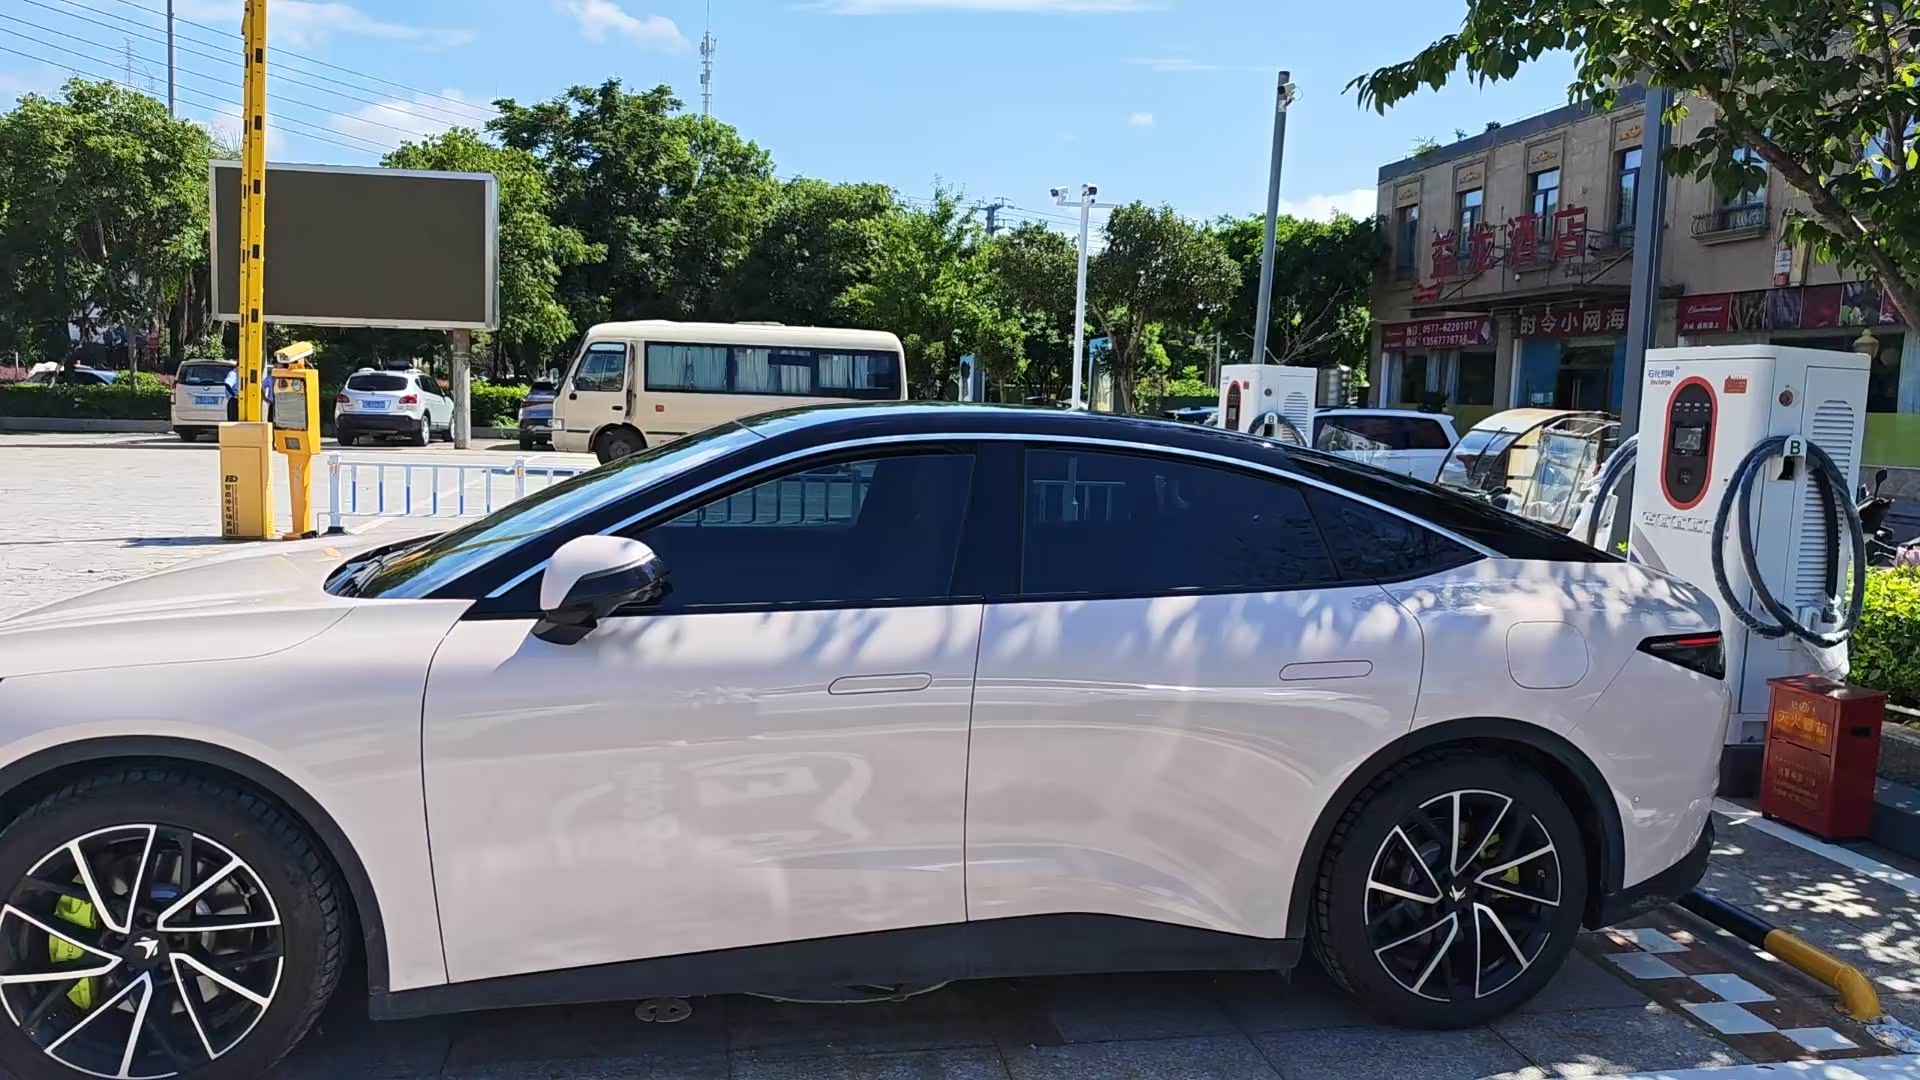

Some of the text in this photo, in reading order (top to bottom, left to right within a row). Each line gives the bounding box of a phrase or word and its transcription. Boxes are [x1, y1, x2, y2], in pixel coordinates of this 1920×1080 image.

[1520, 308, 1626, 335] 时令小网海
[1268, 415, 1275, 424] B
[1790, 440, 1801, 455] B
